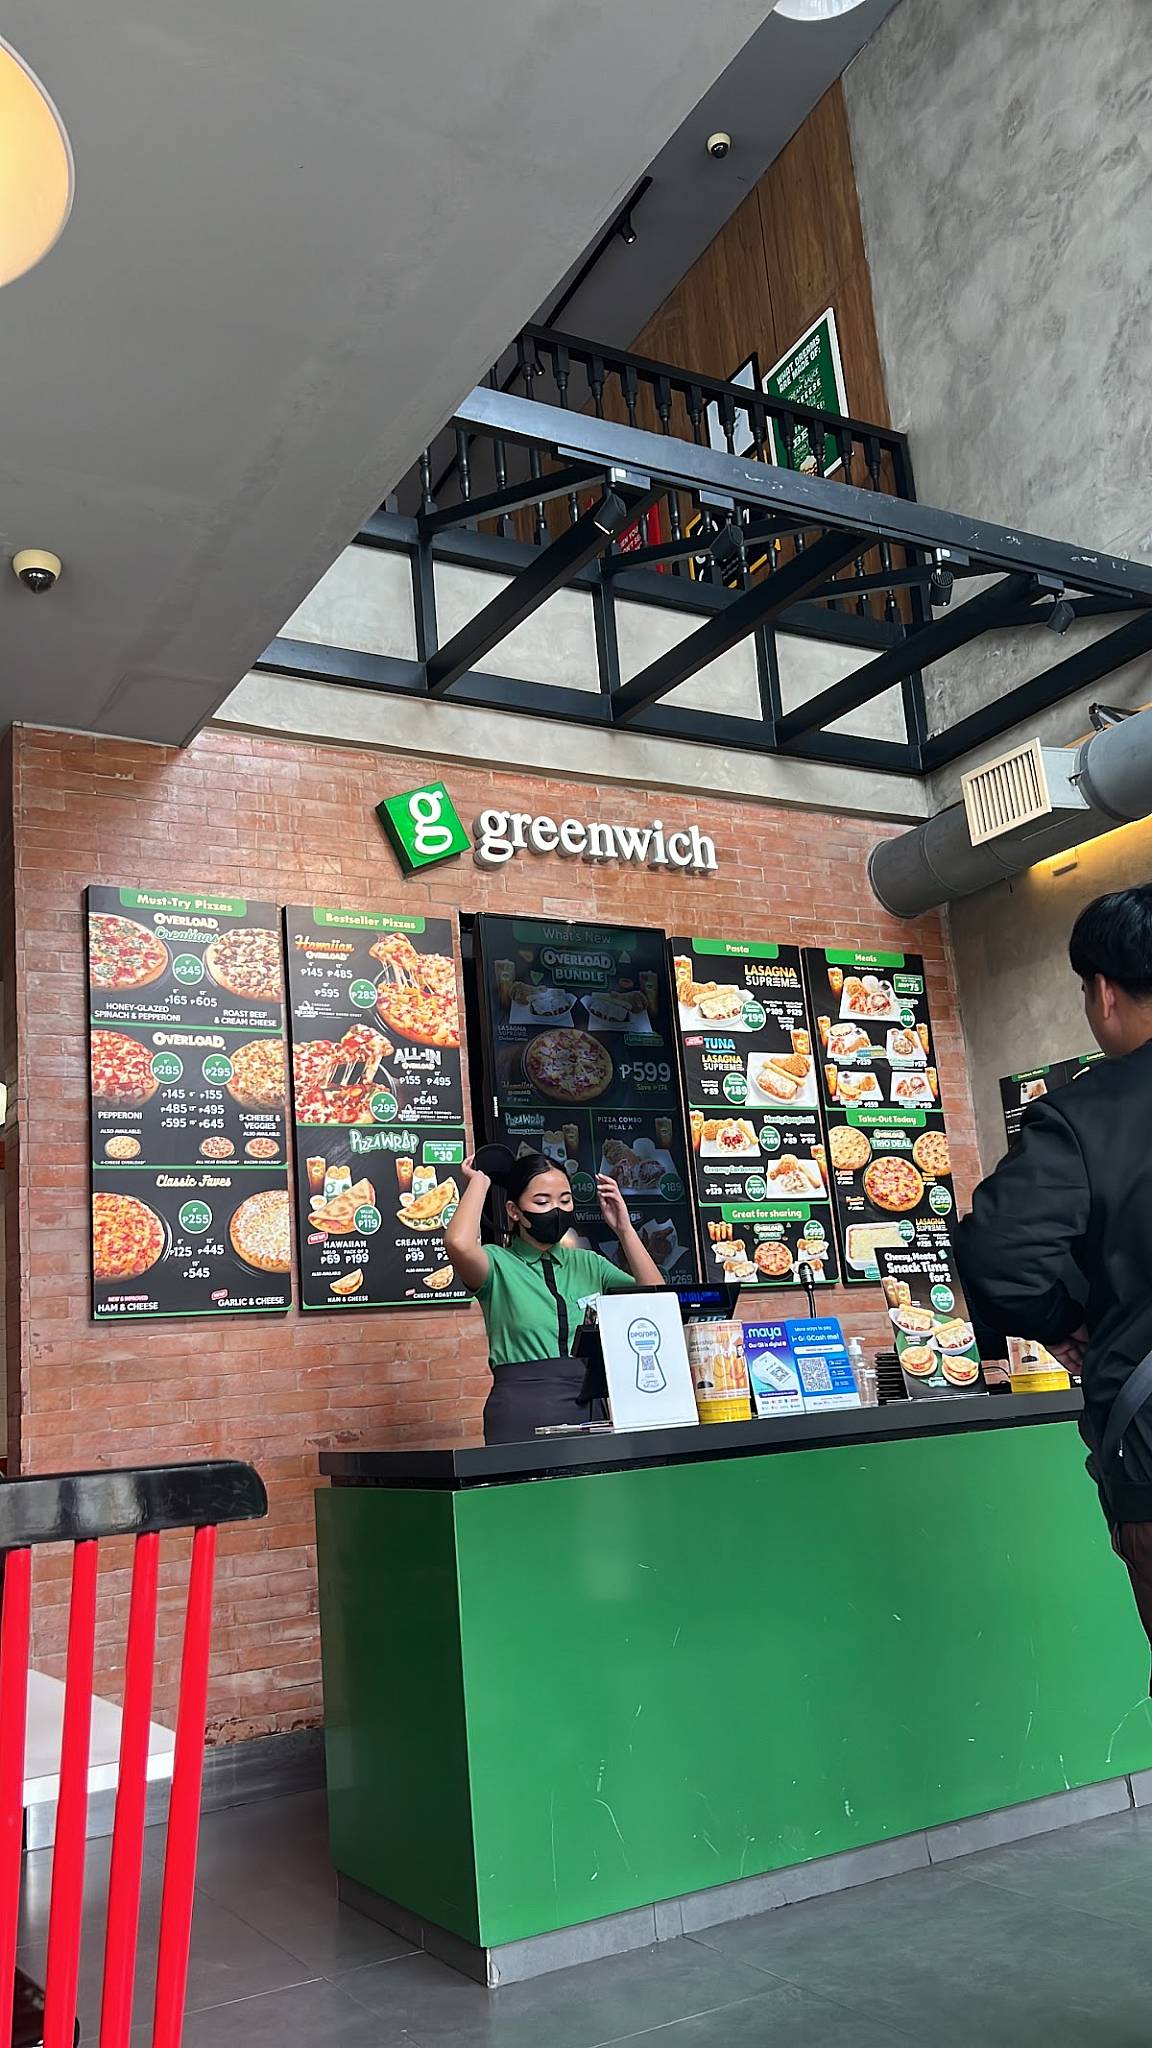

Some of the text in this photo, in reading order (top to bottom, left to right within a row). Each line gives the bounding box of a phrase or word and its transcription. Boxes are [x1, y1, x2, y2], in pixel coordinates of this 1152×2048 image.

[776, 335, 821, 386] WHAT DREAMS
[780, 377, 792, 394] ARE
[792, 358, 810, 381] MADE
[476, 808, 719, 871] greenwich
[137, 894, 233, 912] Must-Try Pizzas
[154, 912, 219, 929] OVERLOAD
[325, 913, 416, 929] Bestseller Pizzas
[154, 926, 221, 944] Creations
[543, 927, 611, 944] What's New
[294, 935, 354, 952] Hawaiian
[726, 944, 750, 954] Pasta
[305, 951, 347, 961] OVERLOAD
[543, 949, 612, 969] OVERLOAD
[855, 953, 878, 963] Meals
[555, 969, 604, 982] BUNDLE
[744, 964, 798, 978] LASAGNA
[745, 975, 800, 988] SUPREME
[106, 1003, 170, 1013] HONEY-GLAZED
[94, 1010, 131, 1019] SPINACH
[138, 1012, 181, 1022] PEPPERONI
[223, 1009, 268, 1019] ROAST BEEF
[221, 1017, 249, 1026] CREAM
[249, 1018, 277, 1027] CHEESE
[152, 1032, 225, 1048] OVERLOAD
[703, 1037, 736, 1050] TUNA
[393, 1047, 442, 1066] ALL-IN
[701, 1054, 743, 1064] LASAGNA
[401, 1062, 436, 1070] OVERLOAD
[703, 1062, 745, 1072] SUPREME
[98, 1111, 143, 1120] PEPPERONI
[239, 1114, 274, 1122] 5-CHEESE
[618, 1116, 643, 1124] COMBO
[857, 1114, 917, 1126] Take-Out Today
[244, 1122, 277, 1130] VEGGIES
[872, 1139, 913, 1148] TRIO DEAL
[156, 1174, 232, 1188] Classic Faves
[732, 1208, 802, 1219] Great for sharing
[915, 1217, 946, 1225] LASAGNA
[323, 1240, 367, 1248] HAWAIIAN
[395, 1238, 429, 1247] CREAMY
[912, 1252, 938, 1262] Meaty
[886, 1262, 922, 1274] Snack
[920, 1261, 949, 1273] Time
[928, 1272, 952, 1283] for 2
[97, 1302, 159, 1312] HAM & CHEESE
[218, 1297, 285, 1307] GARLIC & CHEESE
[747, 1326, 783, 1340] maya
